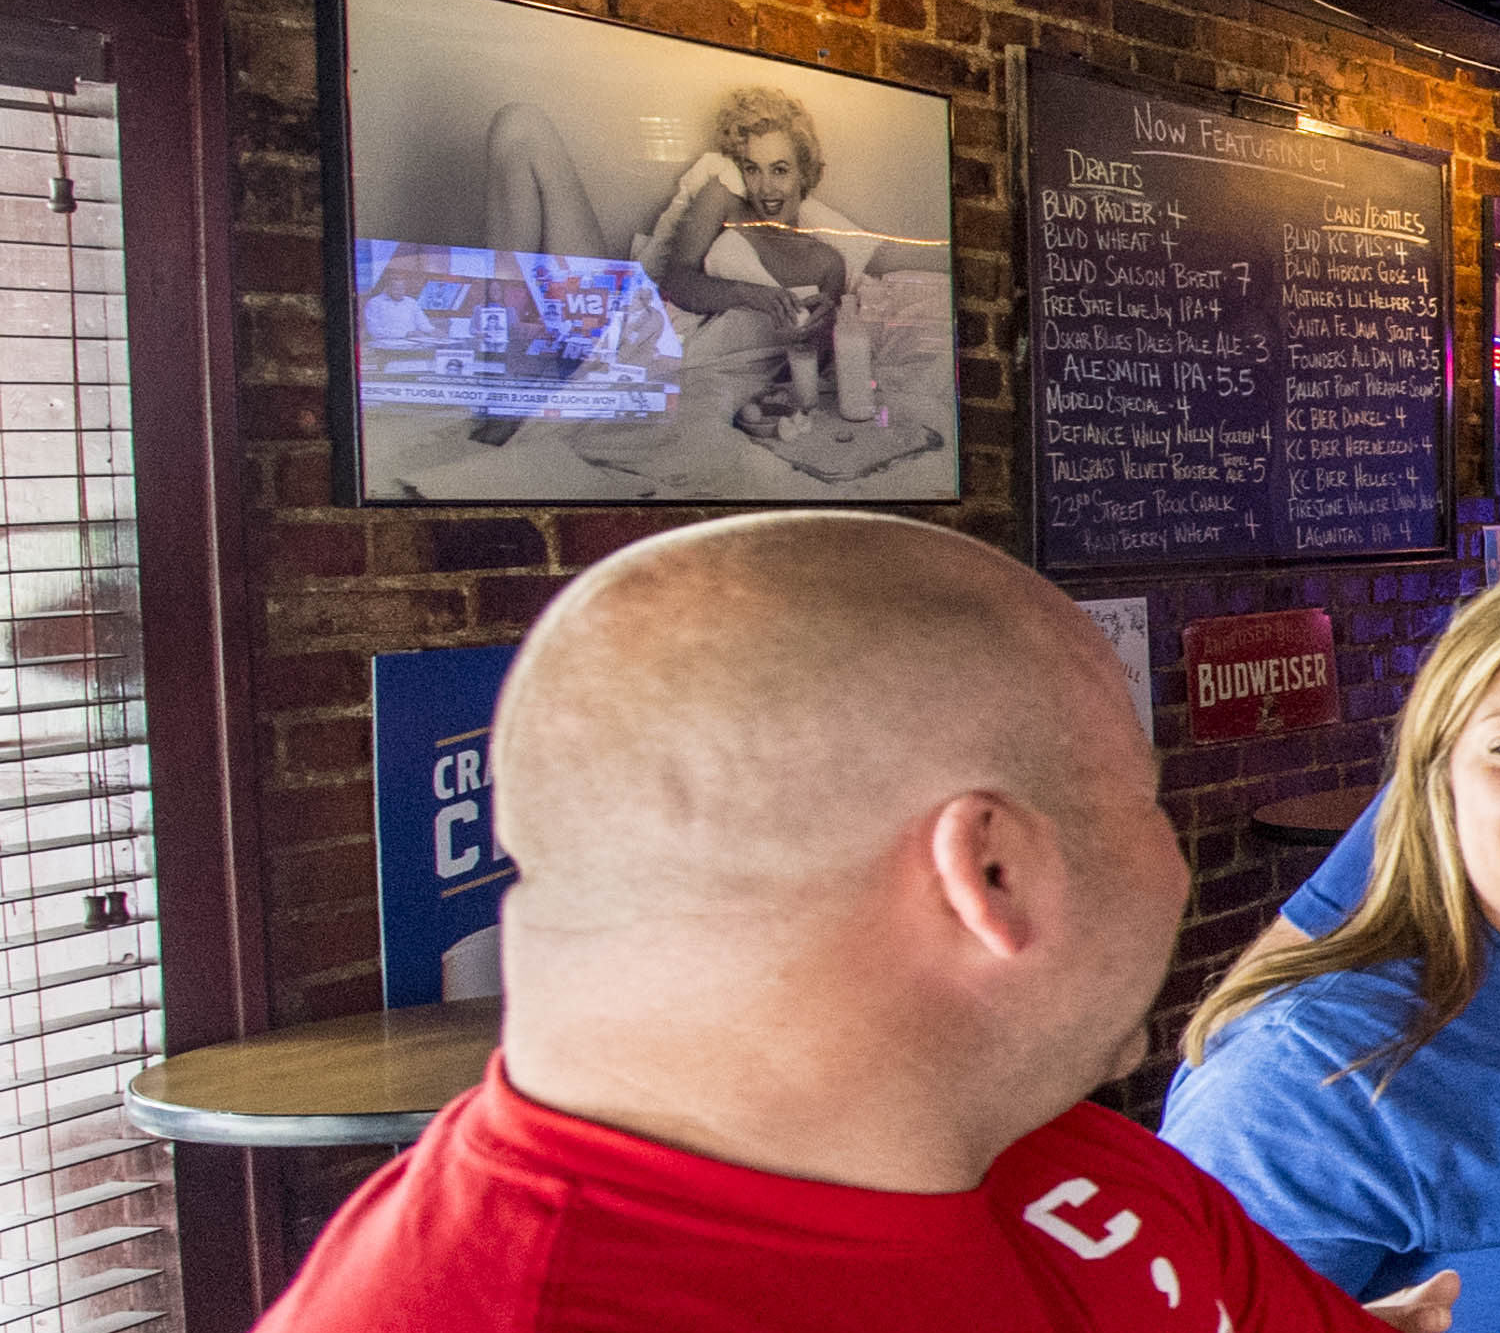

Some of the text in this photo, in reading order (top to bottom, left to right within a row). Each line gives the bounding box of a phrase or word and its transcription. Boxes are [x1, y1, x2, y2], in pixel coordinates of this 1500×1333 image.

[1065, 149, 1144, 188] DRAFTS
[1042, 189, 1156, 225] BLVD RADLER
[1043, 223, 1151, 251] BLVD WHEAT
[1283, 223, 1349, 255] BLVD KC
[1046, 252, 1166, 286] BLVD SAISON
[1042, 286, 1076, 316] FREE
[1045, 321, 1213, 355] OSKAR PALE
[1063, 353, 1208, 392] ALESMITH IPA
[1046, 380, 1104, 414] MODELO
[1285, 408, 1307, 432] KC
[1046, 419, 1215, 459] DEFIANCE WILLY NILLY
[1120, 451, 1169, 480] VELVET
[1091, 489, 1147, 524] STREET
[1198, 653, 1329, 708] BUDWEISER
